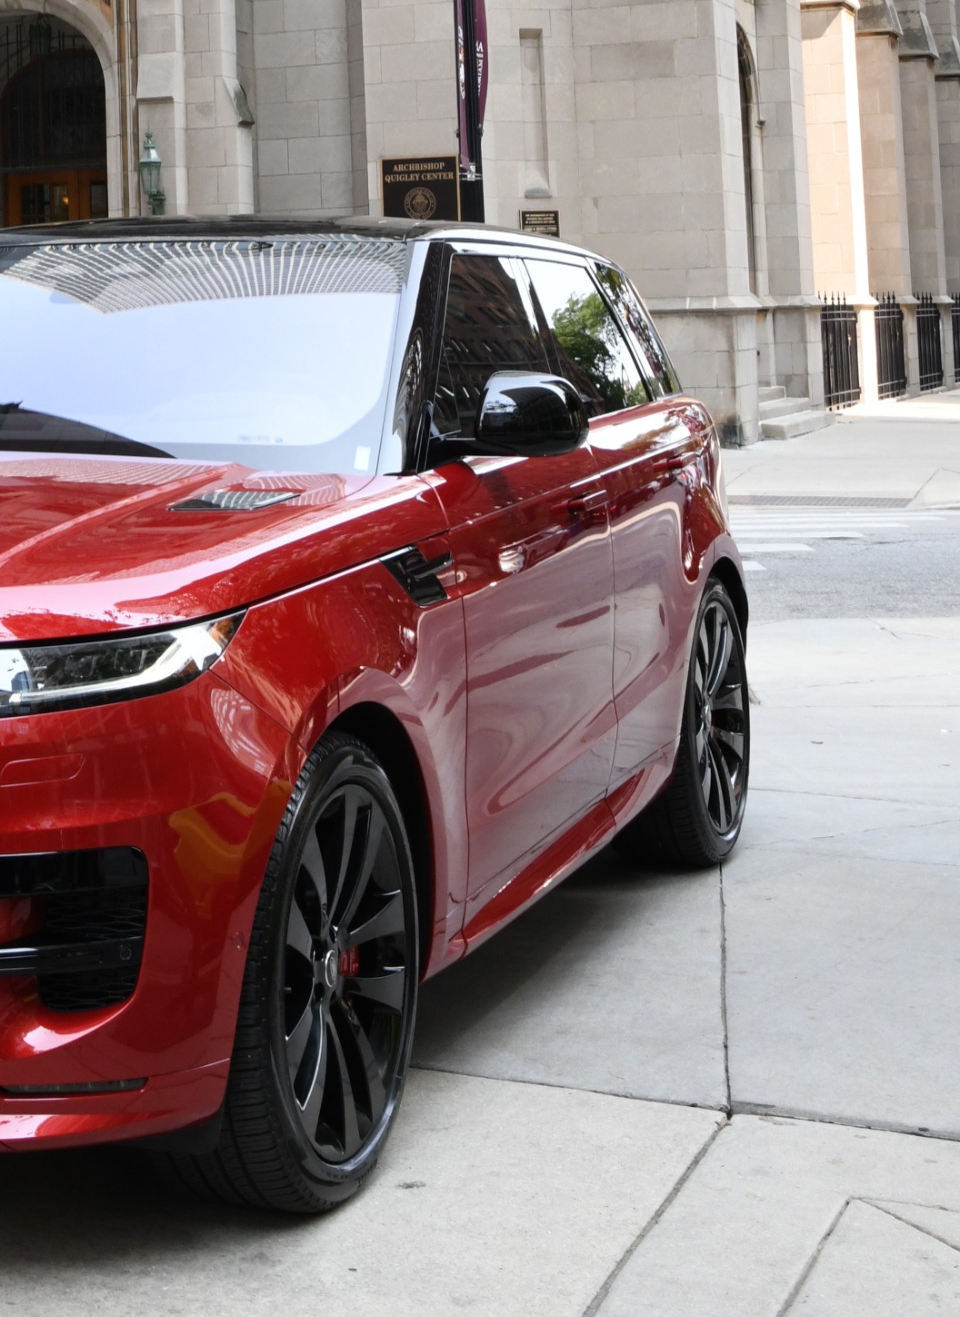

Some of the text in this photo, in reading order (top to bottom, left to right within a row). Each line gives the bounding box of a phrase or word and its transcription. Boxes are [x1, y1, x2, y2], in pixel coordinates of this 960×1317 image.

[393, 162, 445, 172] ARCHBISHOP
[384, 172, 454, 183] QUIGLEY CENTER
